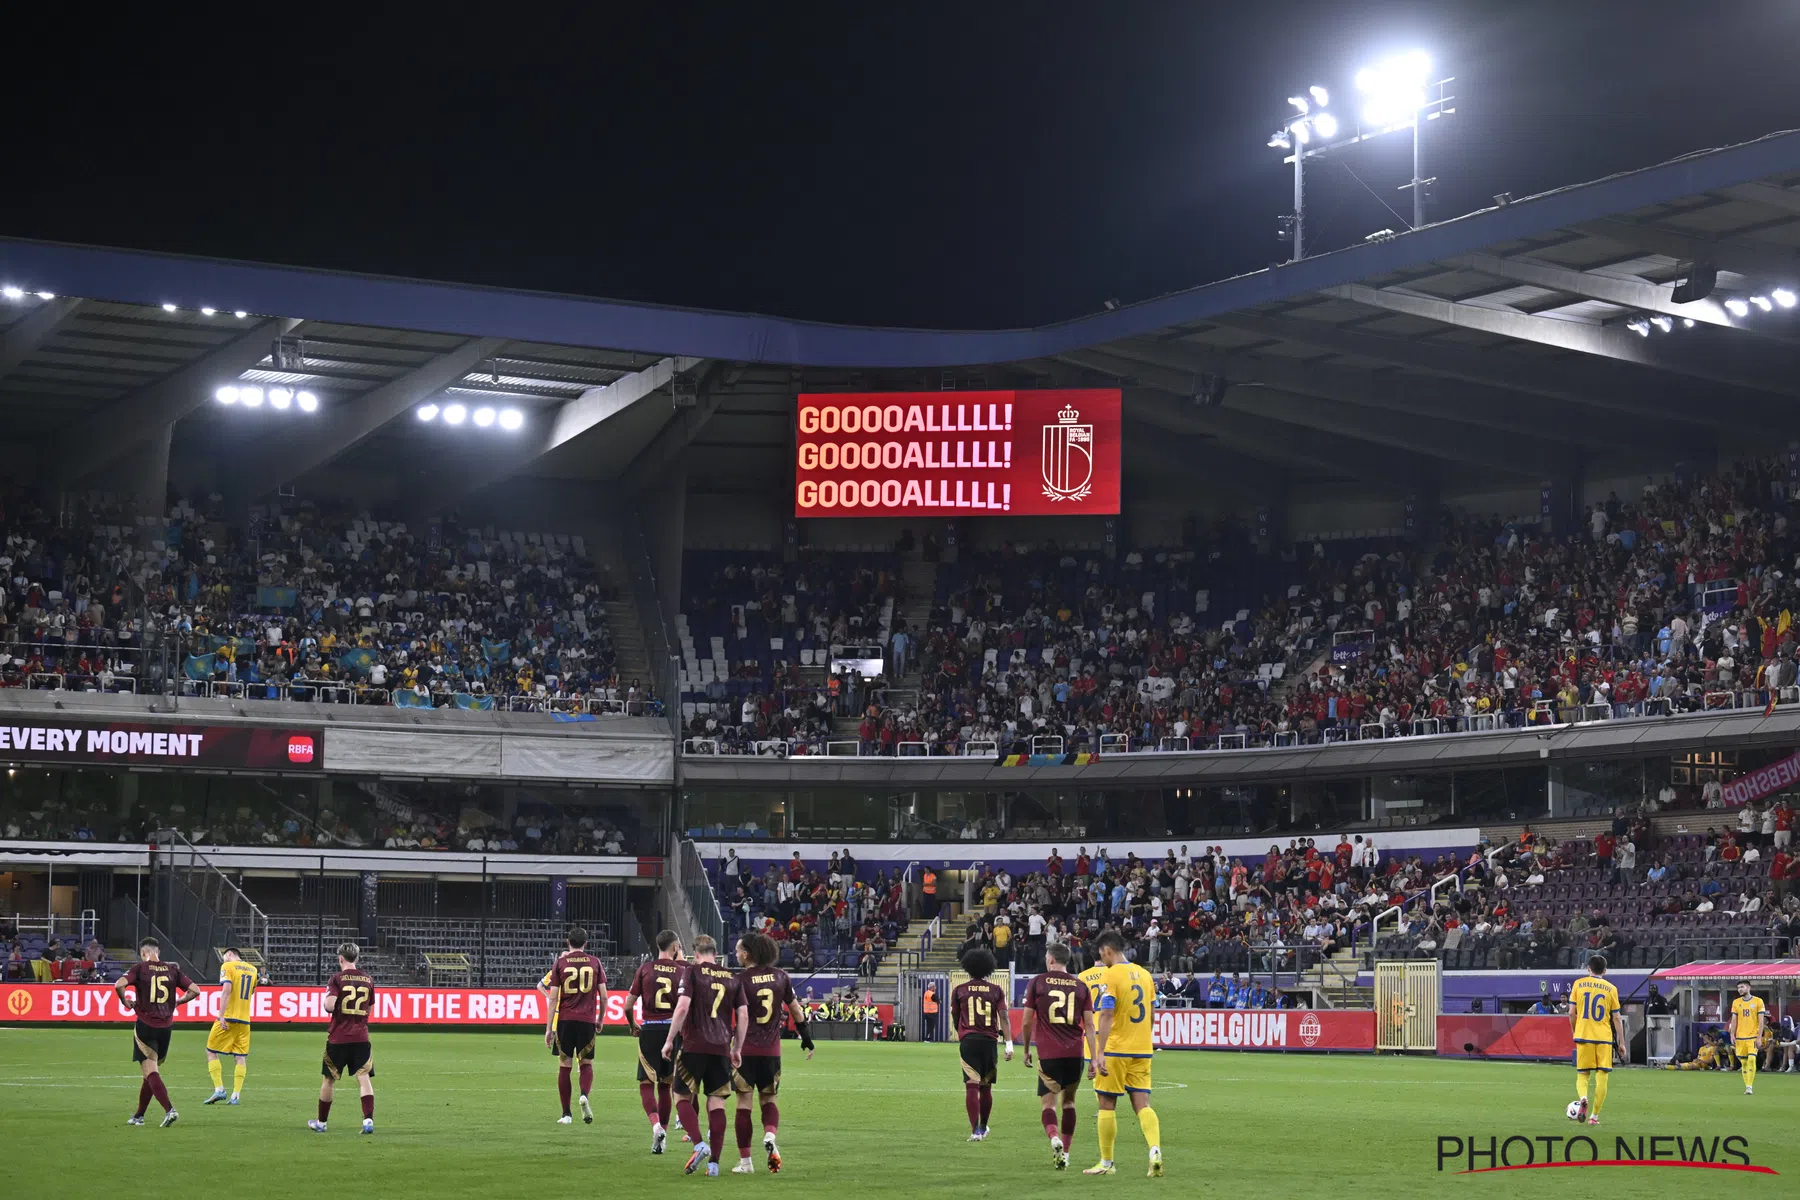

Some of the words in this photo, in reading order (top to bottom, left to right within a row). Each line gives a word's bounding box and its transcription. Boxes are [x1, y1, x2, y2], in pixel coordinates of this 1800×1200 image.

[799, 403, 1013, 433] GOOOOALLLLL!
[799, 441, 1013, 470] GOOOOALLLLL!
[797, 479, 1011, 511] GOOOOALLLLL!
[0, 727, 82, 751] EVERY
[87, 730, 203, 756] MOMENT
[288, 744, 313, 755] RBFA
[563, 966, 594, 994] 20
[653, 964, 676, 973] DEBAST
[751, 974, 775, 984] THEATE
[1045, 977, 1077, 987] CASTAGNE
[149, 975, 169, 1004] 15
[240, 973, 250, 1000] 11
[341, 985, 370, 1016] 22
[655, 977, 671, 1009] 2
[710, 983, 725, 1018] 7
[1553, 983, 1561, 993] W
[51, 989, 112, 1017] BUY
[187, 991, 273, 1018] HOE
[374, 993, 401, 1019] IN
[408, 992, 461, 1019] THE
[468, 993, 541, 1019] RBFA
[756, 988, 773, 1024] 3
[968, 996, 991, 1026] 14
[1048, 990, 1075, 1025] 21
[1130, 985, 1145, 1023] 3
[1583, 992, 1605, 1022] 16
[1743, 1009, 1750, 1017] 18
[1152, 1012, 1287, 1046] EONBELGIUM
[1301, 1026, 1319, 1035] 1895
